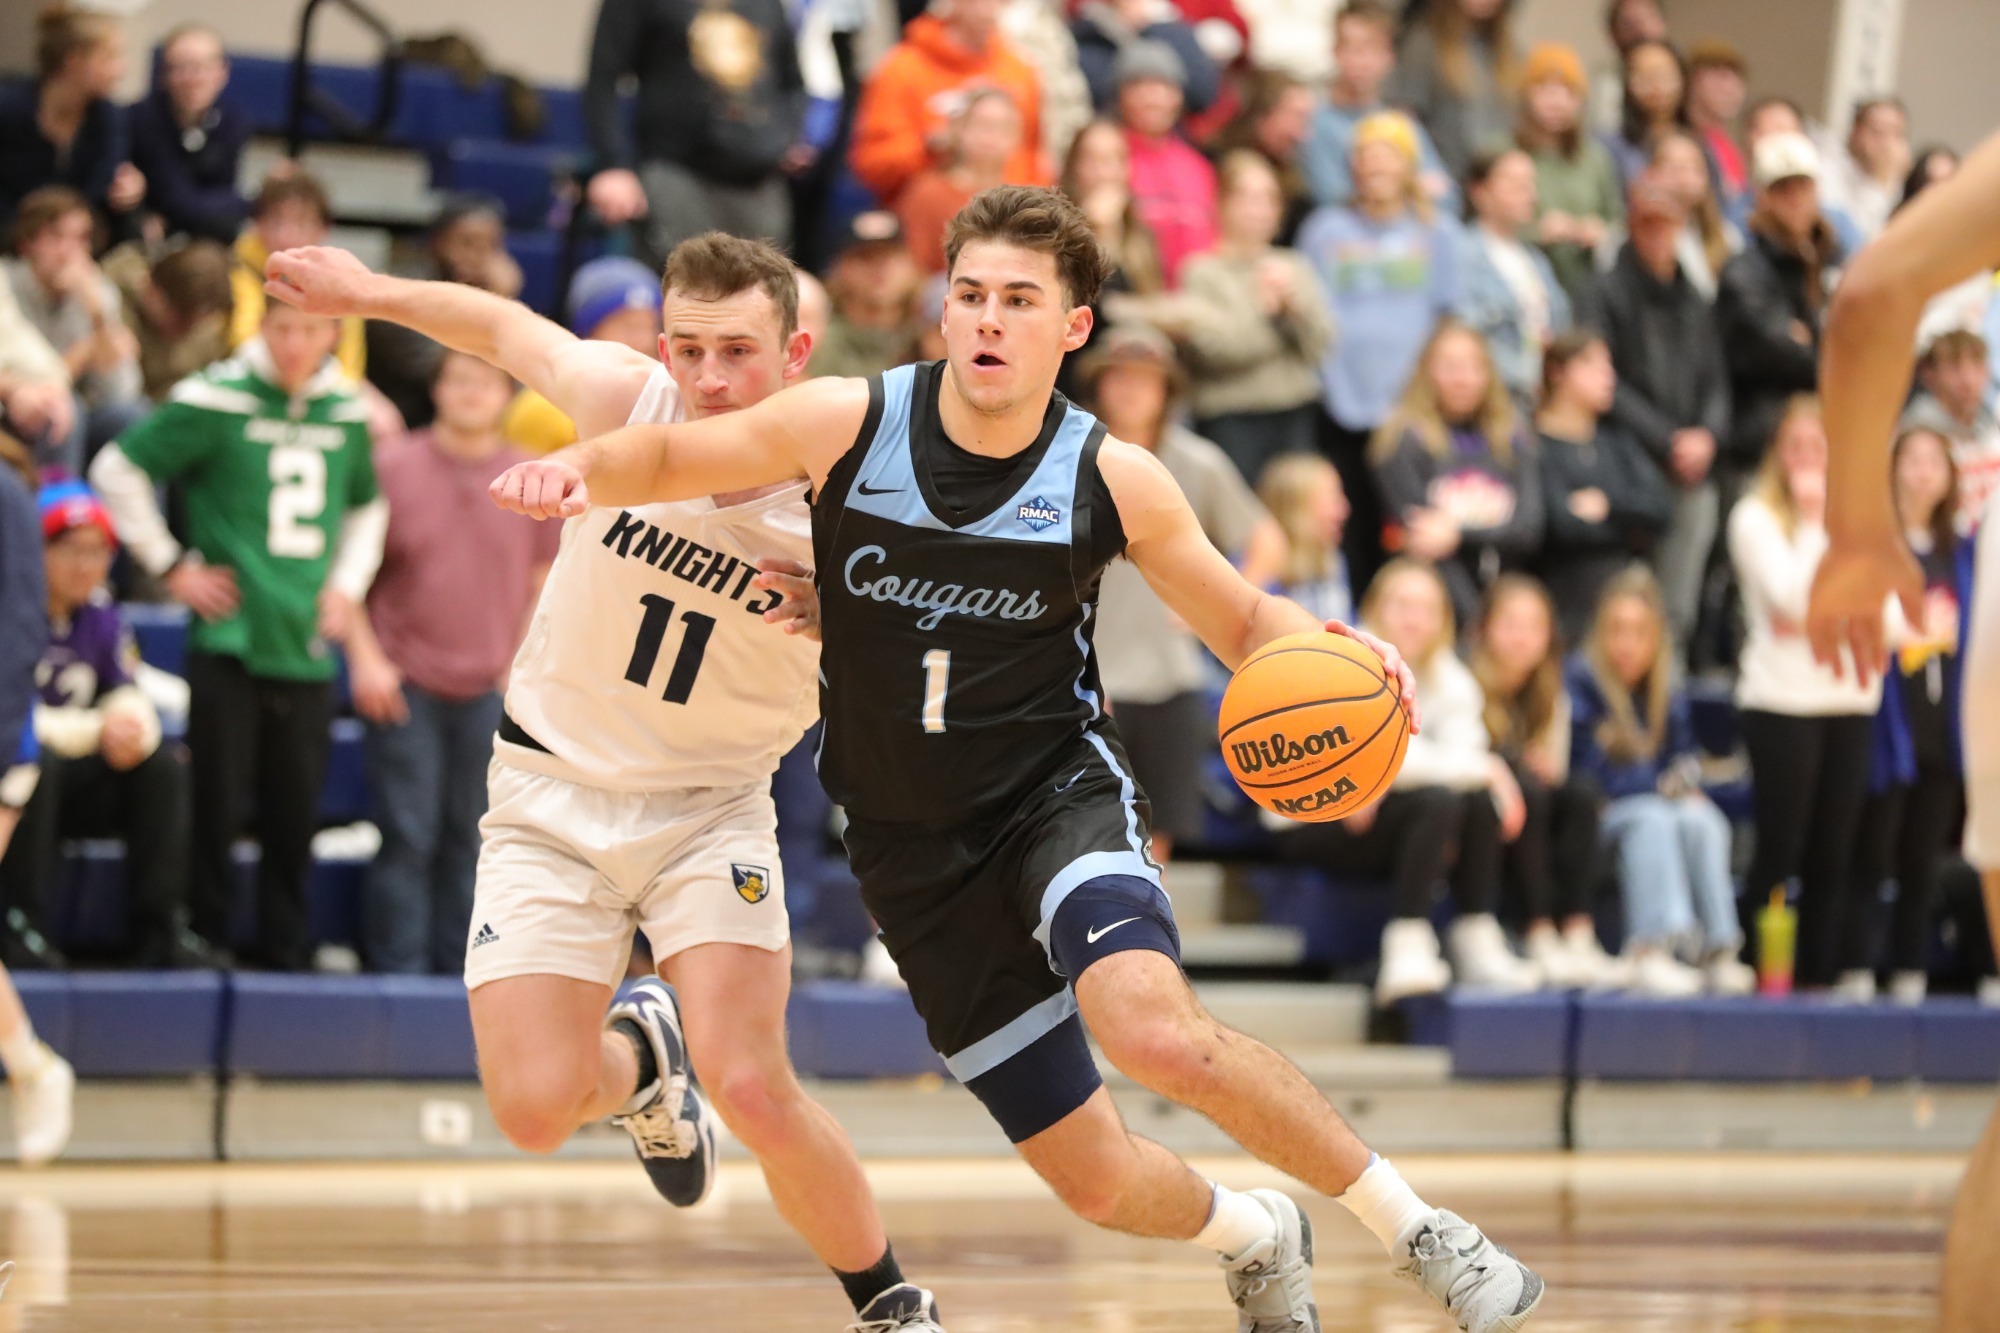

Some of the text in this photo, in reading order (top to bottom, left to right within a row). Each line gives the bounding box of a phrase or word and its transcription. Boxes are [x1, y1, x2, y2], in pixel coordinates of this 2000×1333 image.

[267, 446, 328, 559] 2
[1018, 506, 1059, 523] RMAC
[601, 510, 784, 615] KNIGHTS
[844, 544, 1048, 631] Cougars
[624, 593, 717, 705] 11
[921, 648, 951, 734] 1
[1231, 725, 1351, 774] Wilson
[1270, 775, 1359, 814] NCAA
